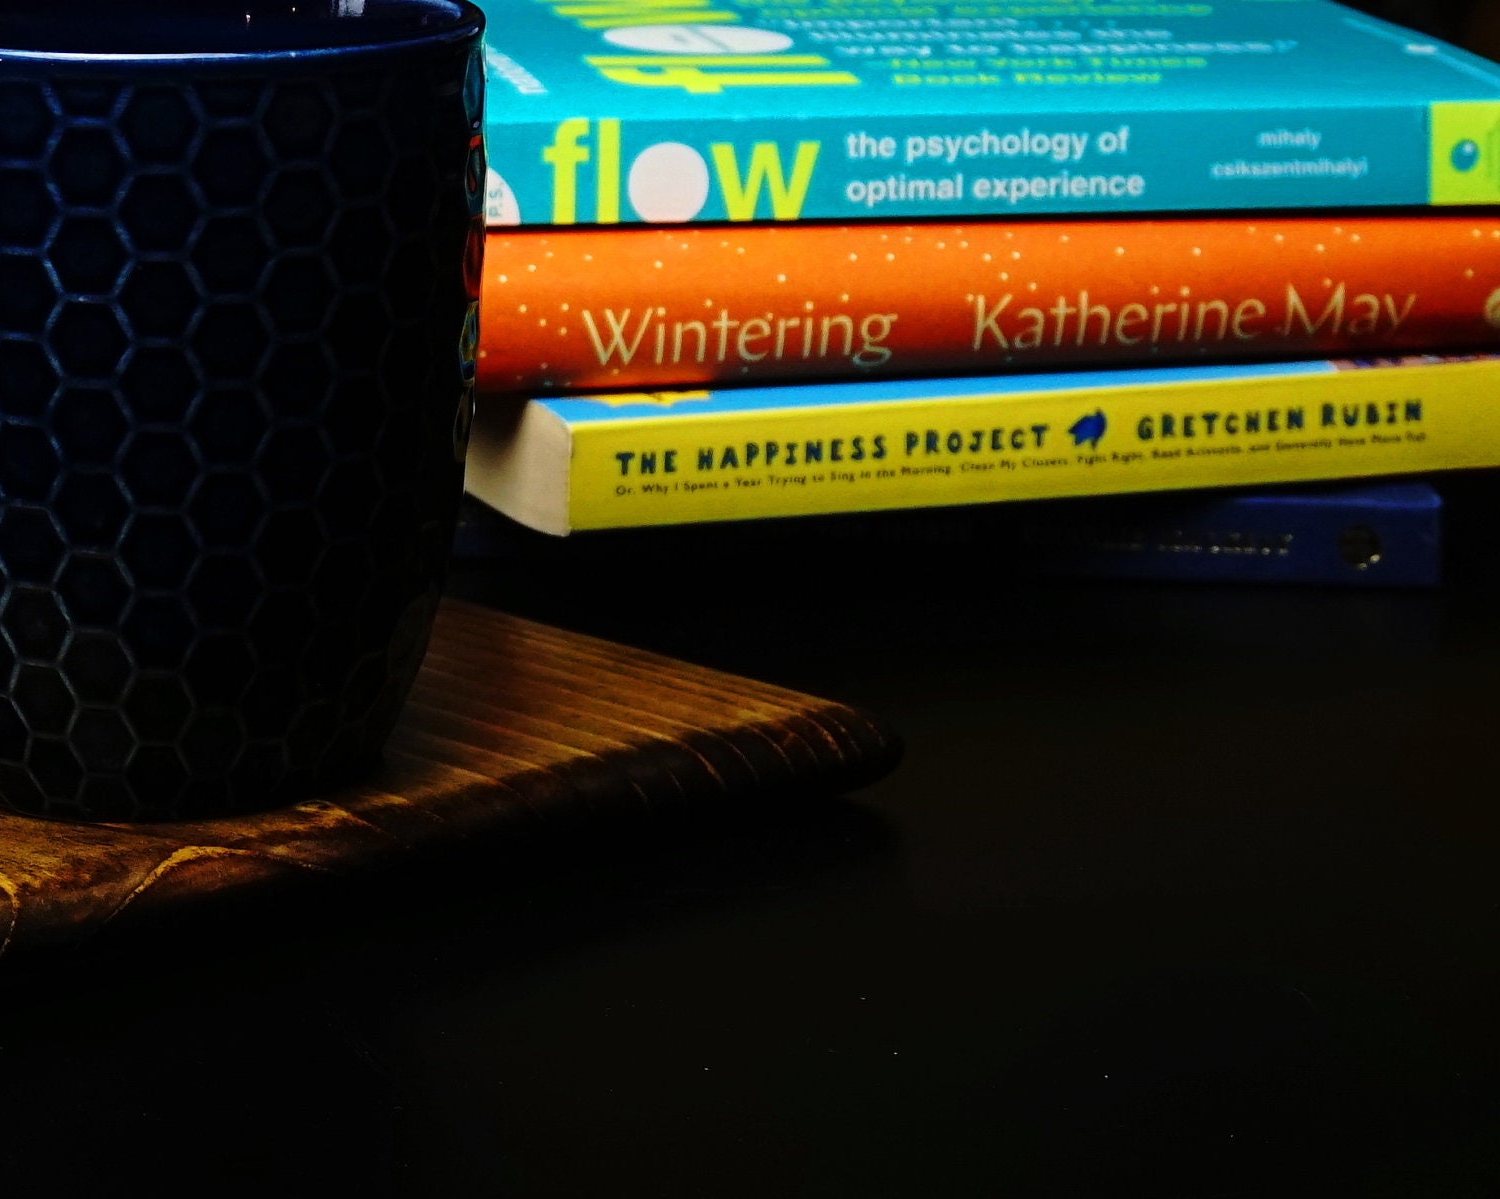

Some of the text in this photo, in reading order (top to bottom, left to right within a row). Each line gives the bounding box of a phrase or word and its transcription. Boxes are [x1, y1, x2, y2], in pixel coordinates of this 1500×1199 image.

[760, 3, 1213, 19] optimal experience
[1090, 27, 1173, 41] the
[835, 43, 932, 58] way
[946, 43, 1000, 56] to
[984, 56, 1075, 70] York
[1088, 56, 1208, 70] Times
[892, 72, 1163, 88] Book Review
[845, 124, 1131, 165] the psychology of
[1257, 128, 1323, 151] mihaly
[541, 116, 825, 226] flow
[1209, 156, 1370, 180] csikszentmihalyi
[846, 170, 1146, 209] optimal experience
[582, 283, 1417, 369] Wintering Katherine May
[1137, 400, 1423, 440] GRETCHEN RUBIN
[615, 425, 1049, 476] THE HAPPINESS PROJECT
[642, 483, 669, 494] Why
[673, 481, 679, 491] I
[683, 480, 719, 492] Spent
[734, 477, 762, 488] Year
[768, 473, 807, 486] Trying
[812, 473, 825, 482] to
[830, 469, 855, 482] Sing
[876, 468, 896, 479] the
[1000, 460, 1017, 471] My
